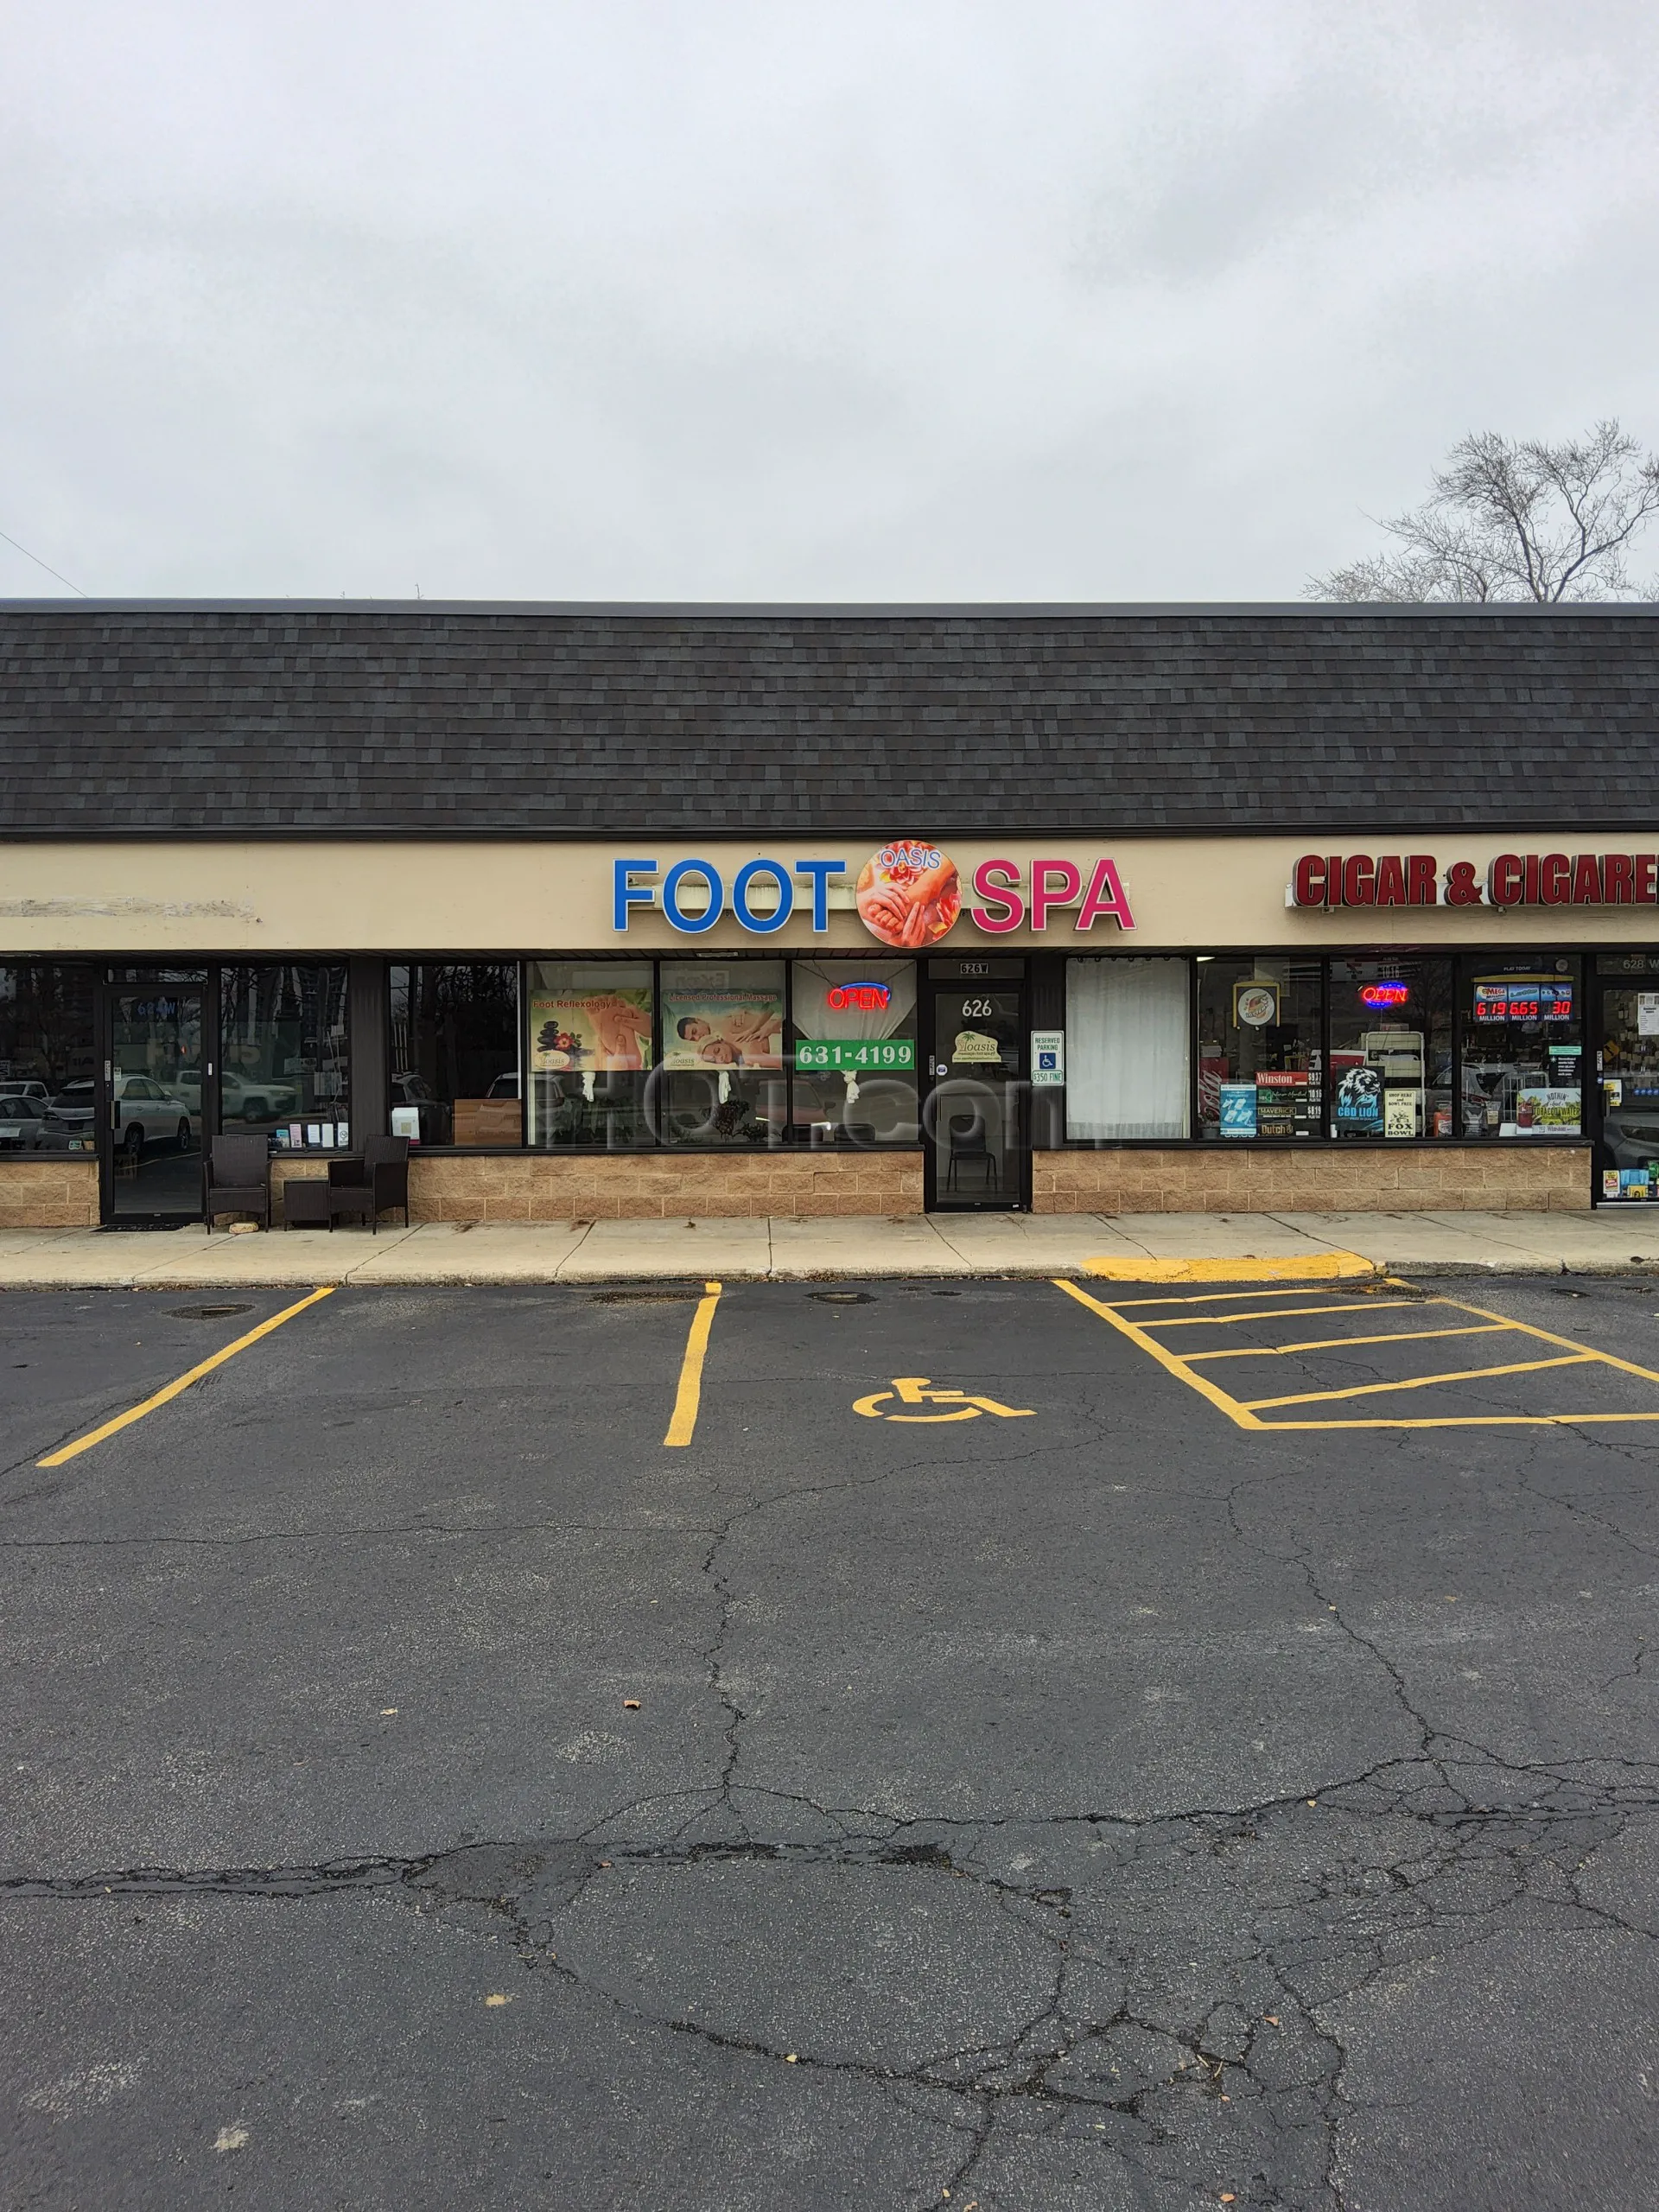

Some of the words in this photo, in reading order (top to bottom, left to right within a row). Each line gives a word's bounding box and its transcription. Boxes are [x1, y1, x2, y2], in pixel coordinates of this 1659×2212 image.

[880, 847, 942, 869] OASIS
[1295, 855, 1437, 906] CIGAR
[1444, 861, 1484, 906] &
[613, 858, 847, 934] FOOT
[970, 858, 1137, 934] SPA
[961, 963, 988, 973] 626W
[1623, 960, 1644, 969] 628
[747, 994, 778, 1002] Massage
[829, 988, 888, 1009] OPEN
[1363, 987, 1408, 1001] OPEN
[556, 1000, 612, 1009] Reflexology
[962, 999, 992, 1017] 626
[1553, 1001, 1571, 1014] 30
[799, 1046, 912, 1064] 631-4199
[1033, 1073, 1048, 1082] $350
[1050, 1073, 1062, 1082] FINE
[1256, 1072, 1293, 1084] Winston
[1338, 1107, 1357, 1117] CBD
[1358, 1107, 1379, 1117] LION
[1262, 1124, 1286, 1135] Dutch
